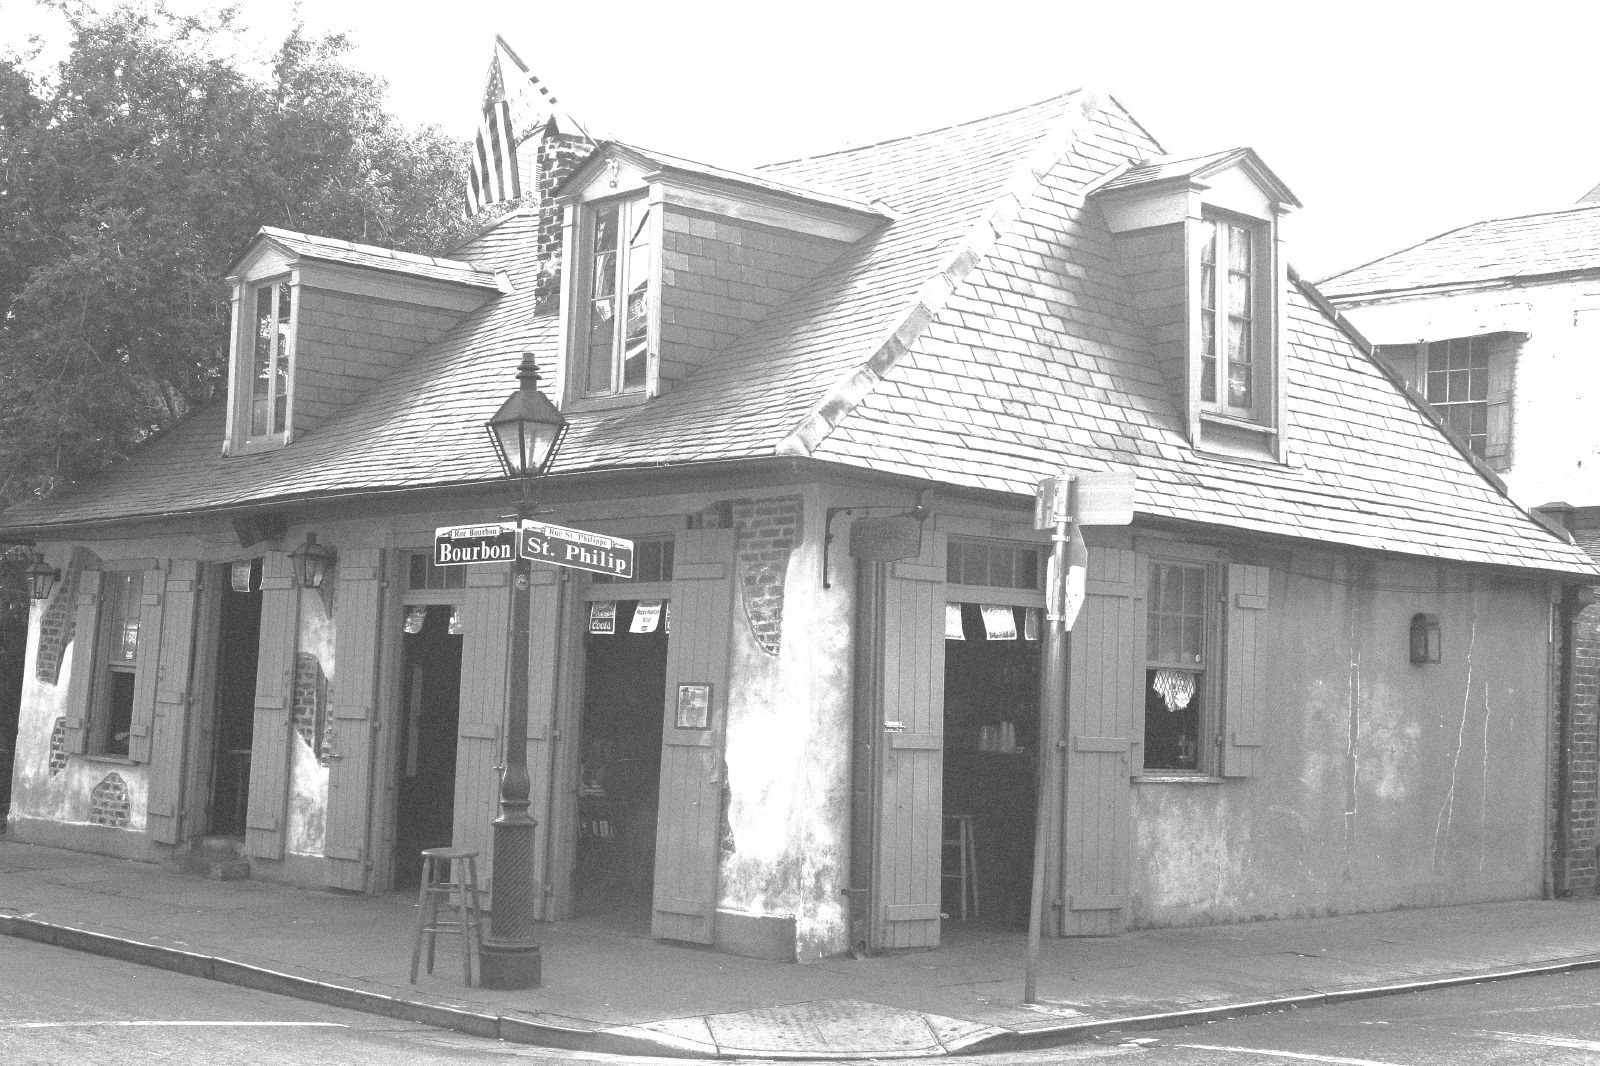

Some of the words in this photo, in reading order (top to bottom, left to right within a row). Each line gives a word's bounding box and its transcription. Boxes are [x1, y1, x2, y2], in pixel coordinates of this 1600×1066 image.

[469, 528, 497, 537] Bourbon
[549, 528, 563, 537] Rue
[578, 533, 608, 546] Philippe
[440, 541, 511, 562] Bourbon
[527, 537, 555, 556] St.
[565, 544, 626, 573] Philip
[591, 619, 611, 630] Coors
